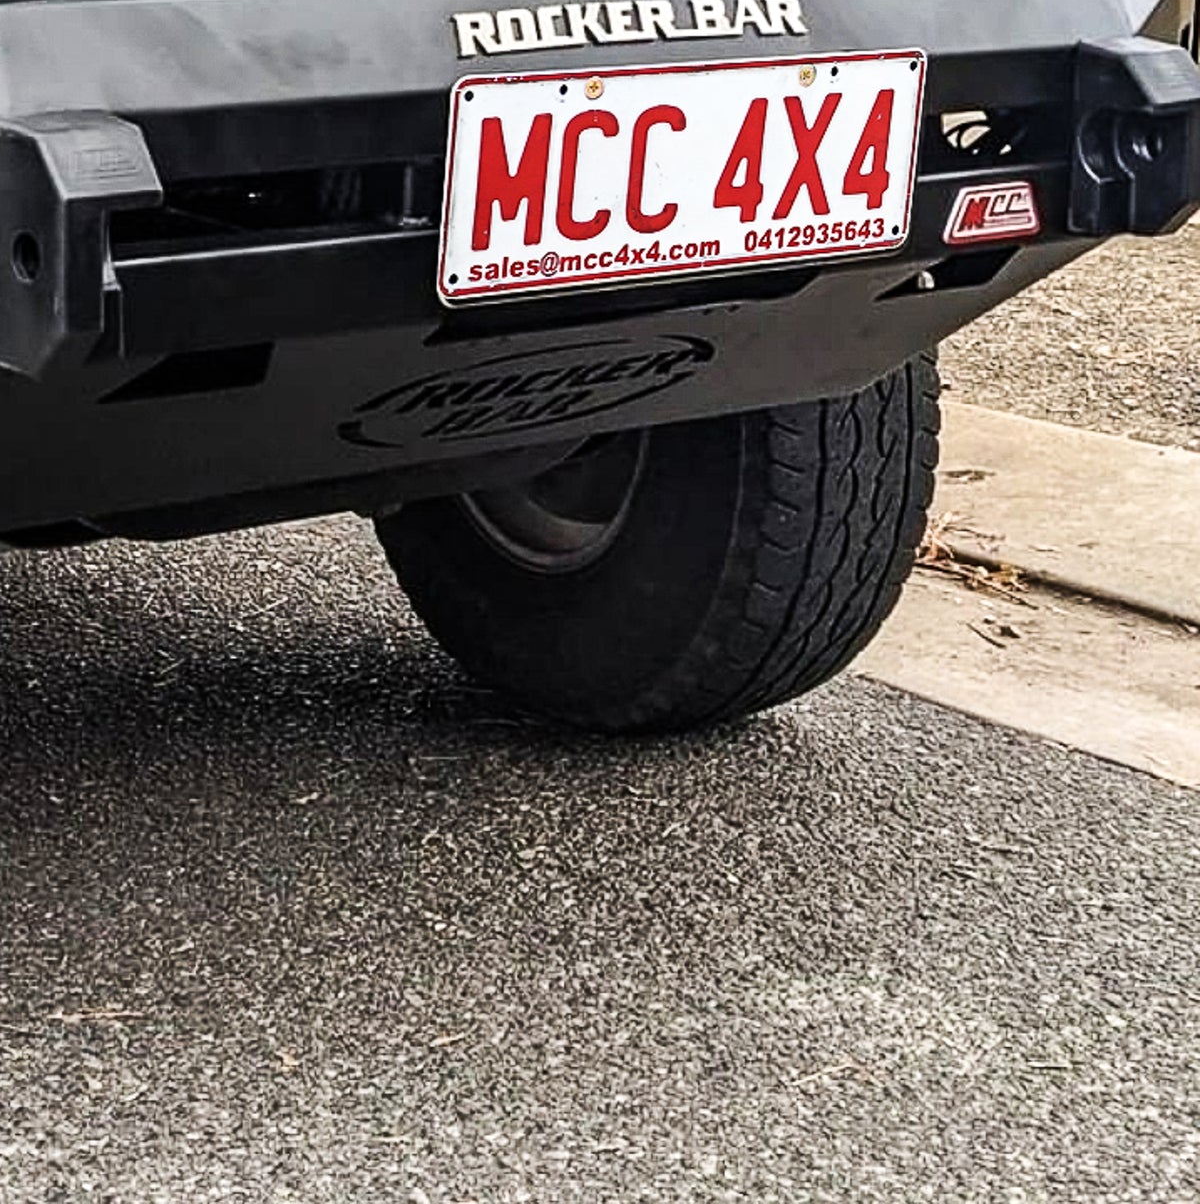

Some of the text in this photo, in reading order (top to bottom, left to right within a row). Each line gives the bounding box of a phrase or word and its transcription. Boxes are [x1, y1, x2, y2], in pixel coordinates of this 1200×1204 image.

[471, 88, 896, 251] MCC 4X4
[957, 192, 1031, 233] MCC
[468, 217, 886, 282] sales@mcc4x4.com 0412935643
